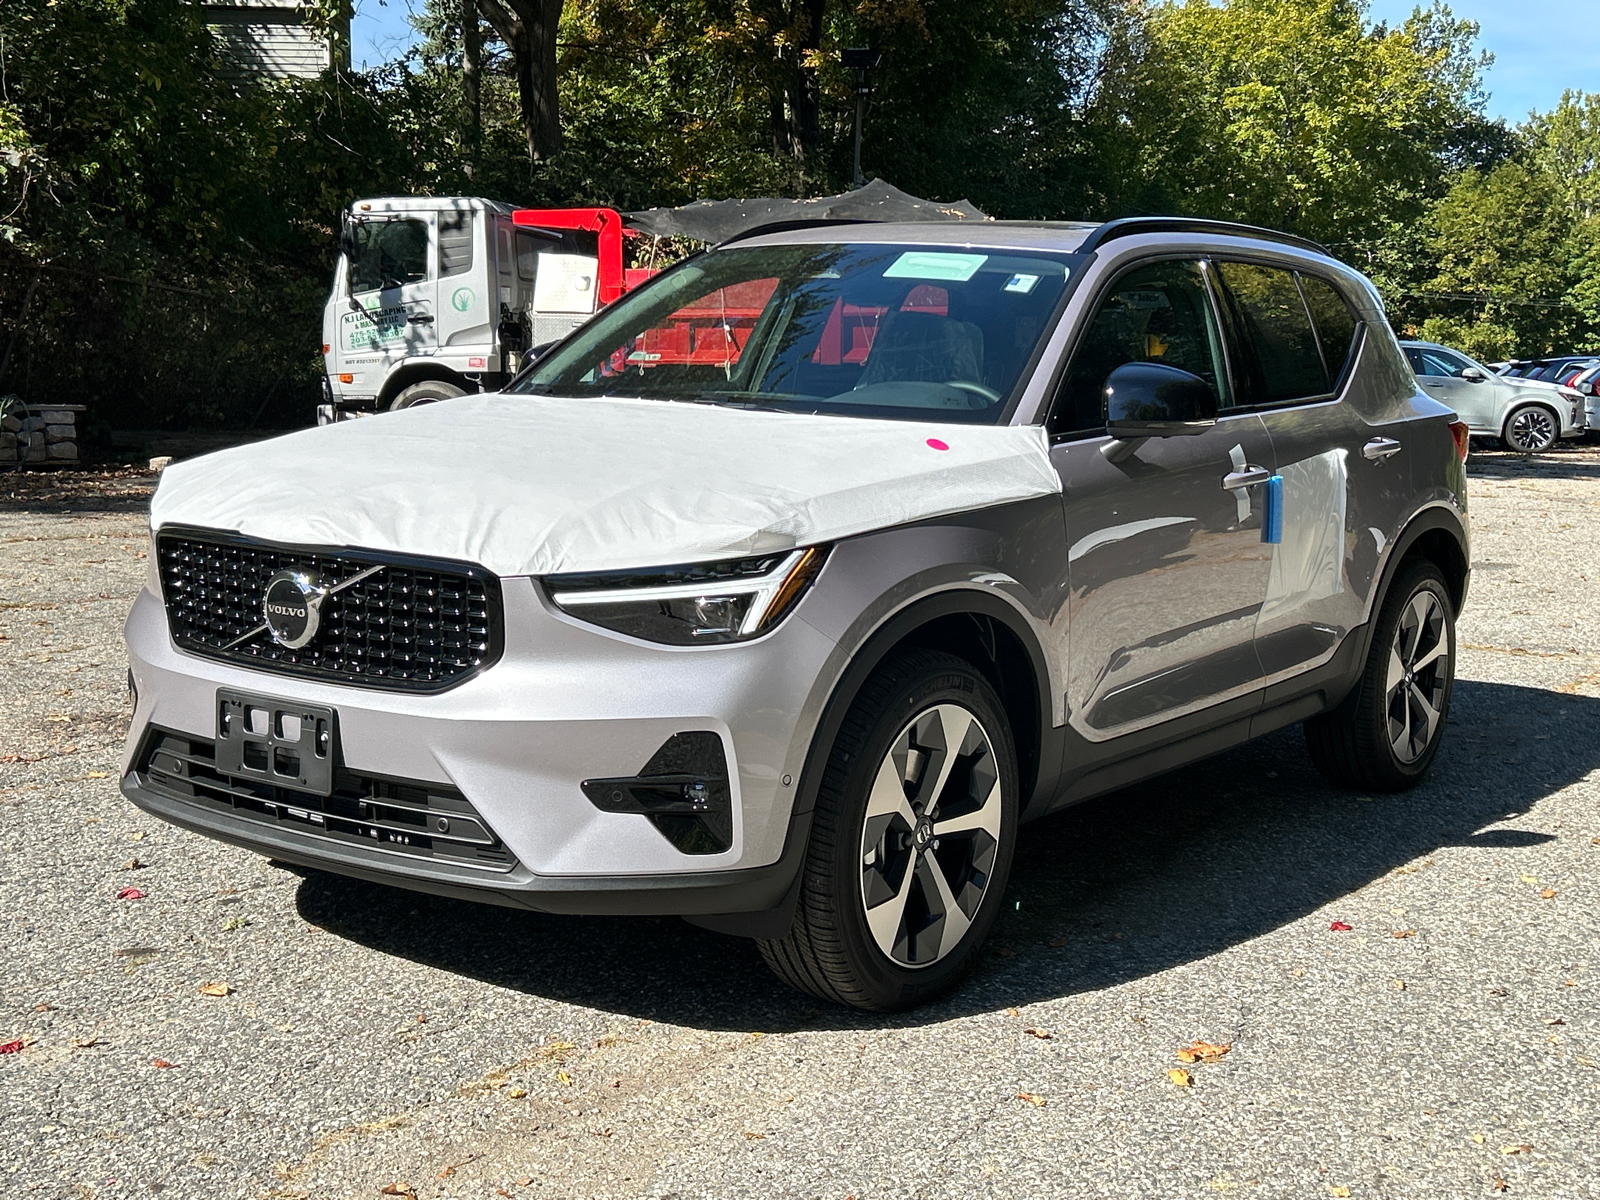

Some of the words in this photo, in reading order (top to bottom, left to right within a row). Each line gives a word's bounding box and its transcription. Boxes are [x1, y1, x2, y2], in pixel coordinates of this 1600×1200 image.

[355, 306, 407, 322] LADSCAPING
[360, 316, 389, 328] MASRY
[388, 315, 399, 323] LLC
[267, 604, 306, 617] VOLVO
